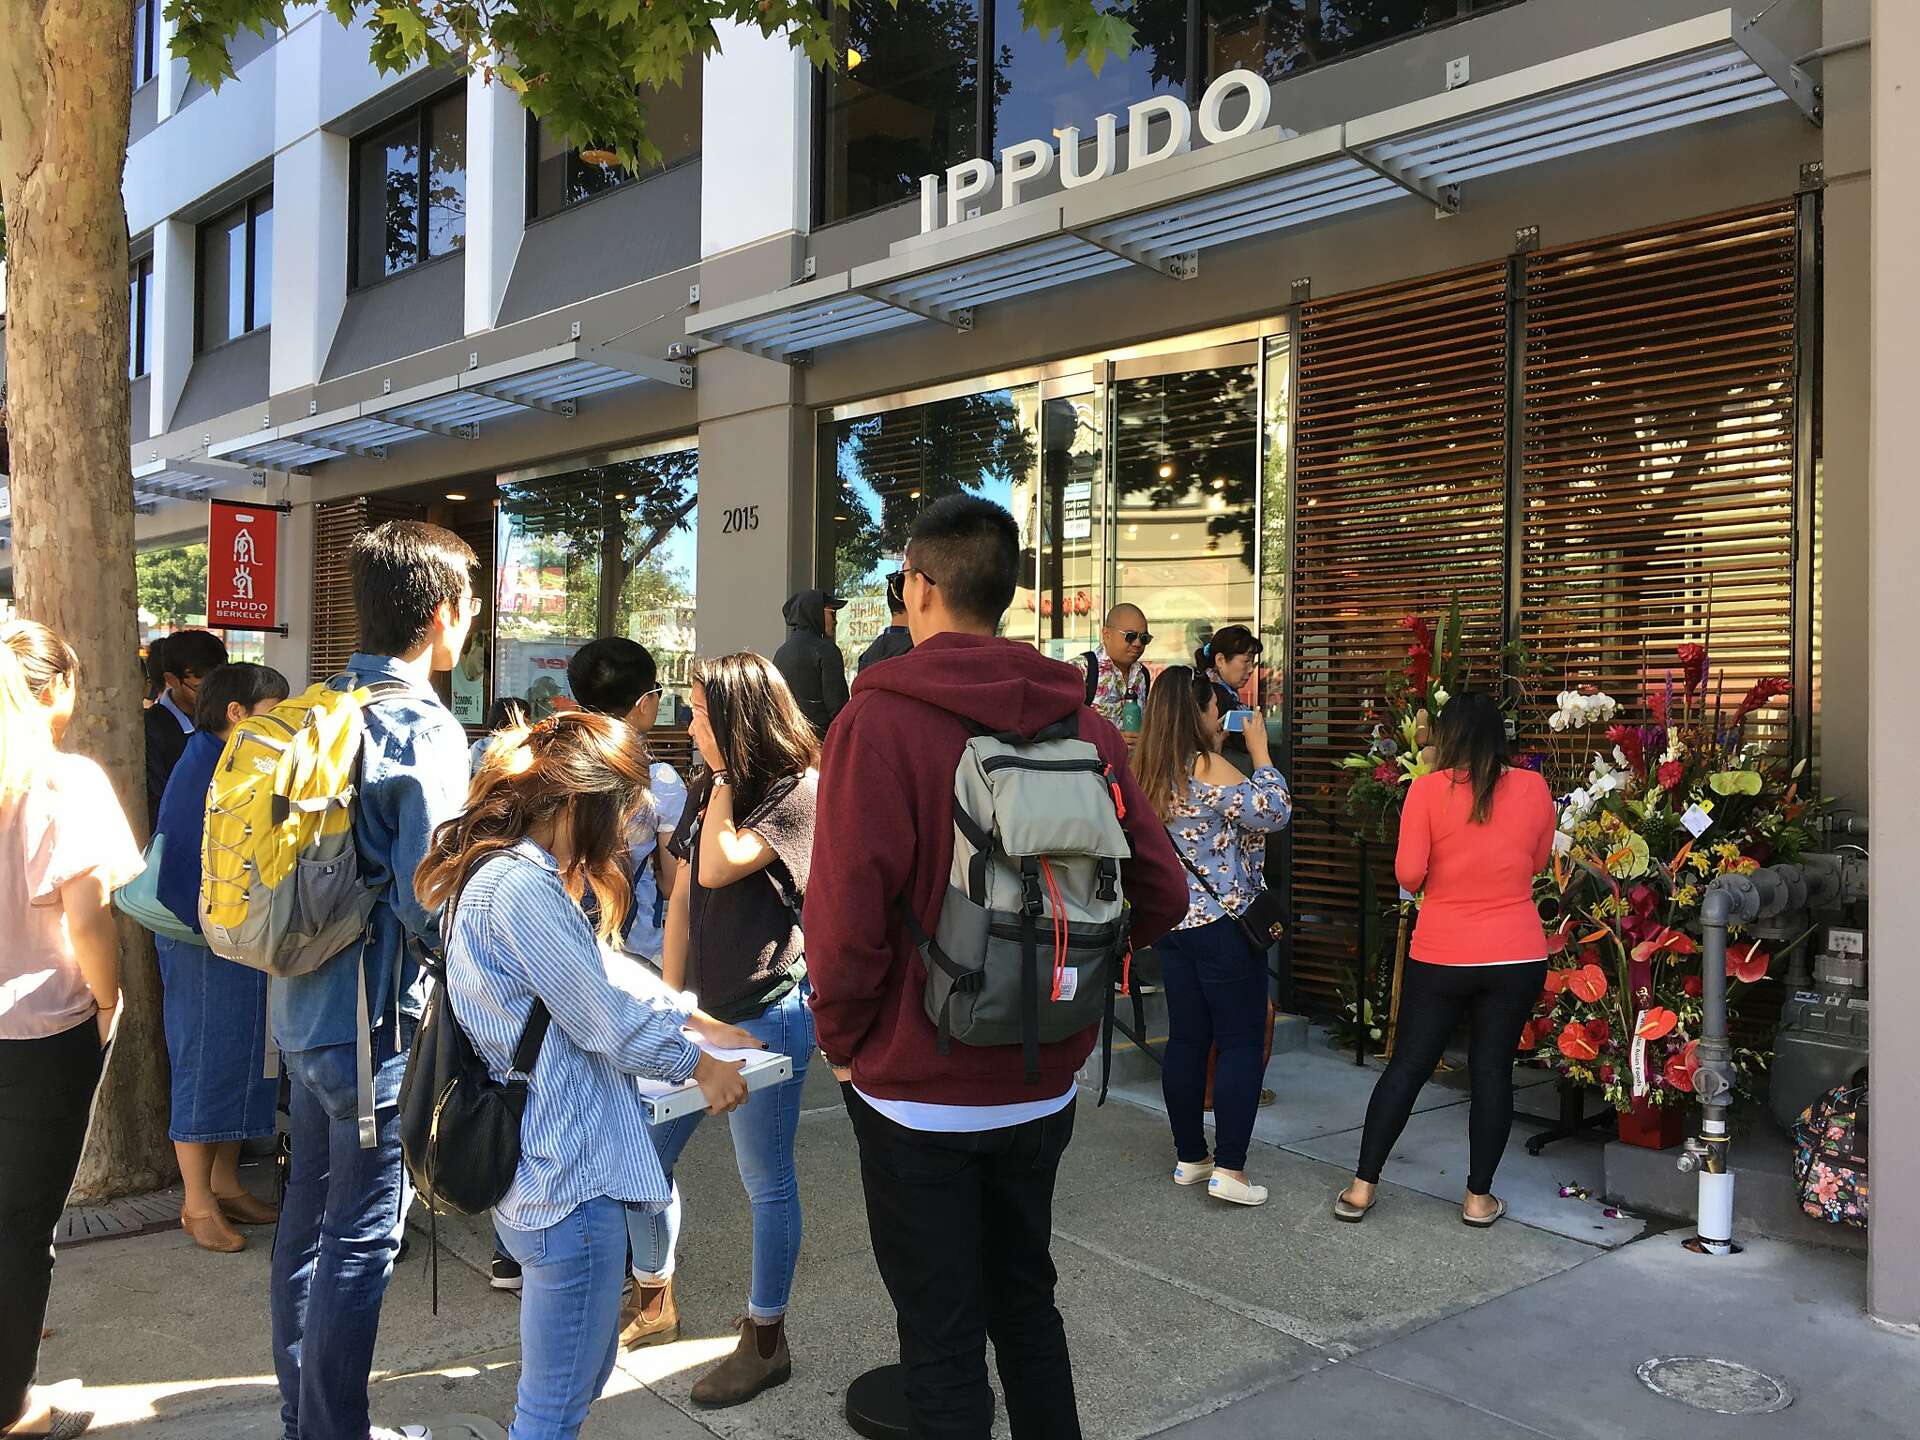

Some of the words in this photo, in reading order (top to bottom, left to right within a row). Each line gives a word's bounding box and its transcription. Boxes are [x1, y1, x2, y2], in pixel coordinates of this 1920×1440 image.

[919, 69, 1271, 235] IPPUDO
[722, 504, 759, 534] 2015
[216, 600, 268, 612] IPPUDO
[216, 610, 267, 620] BERKELEY
[454, 695, 473, 706] COMING
[1635, 1067, 1643, 1087] Foods
